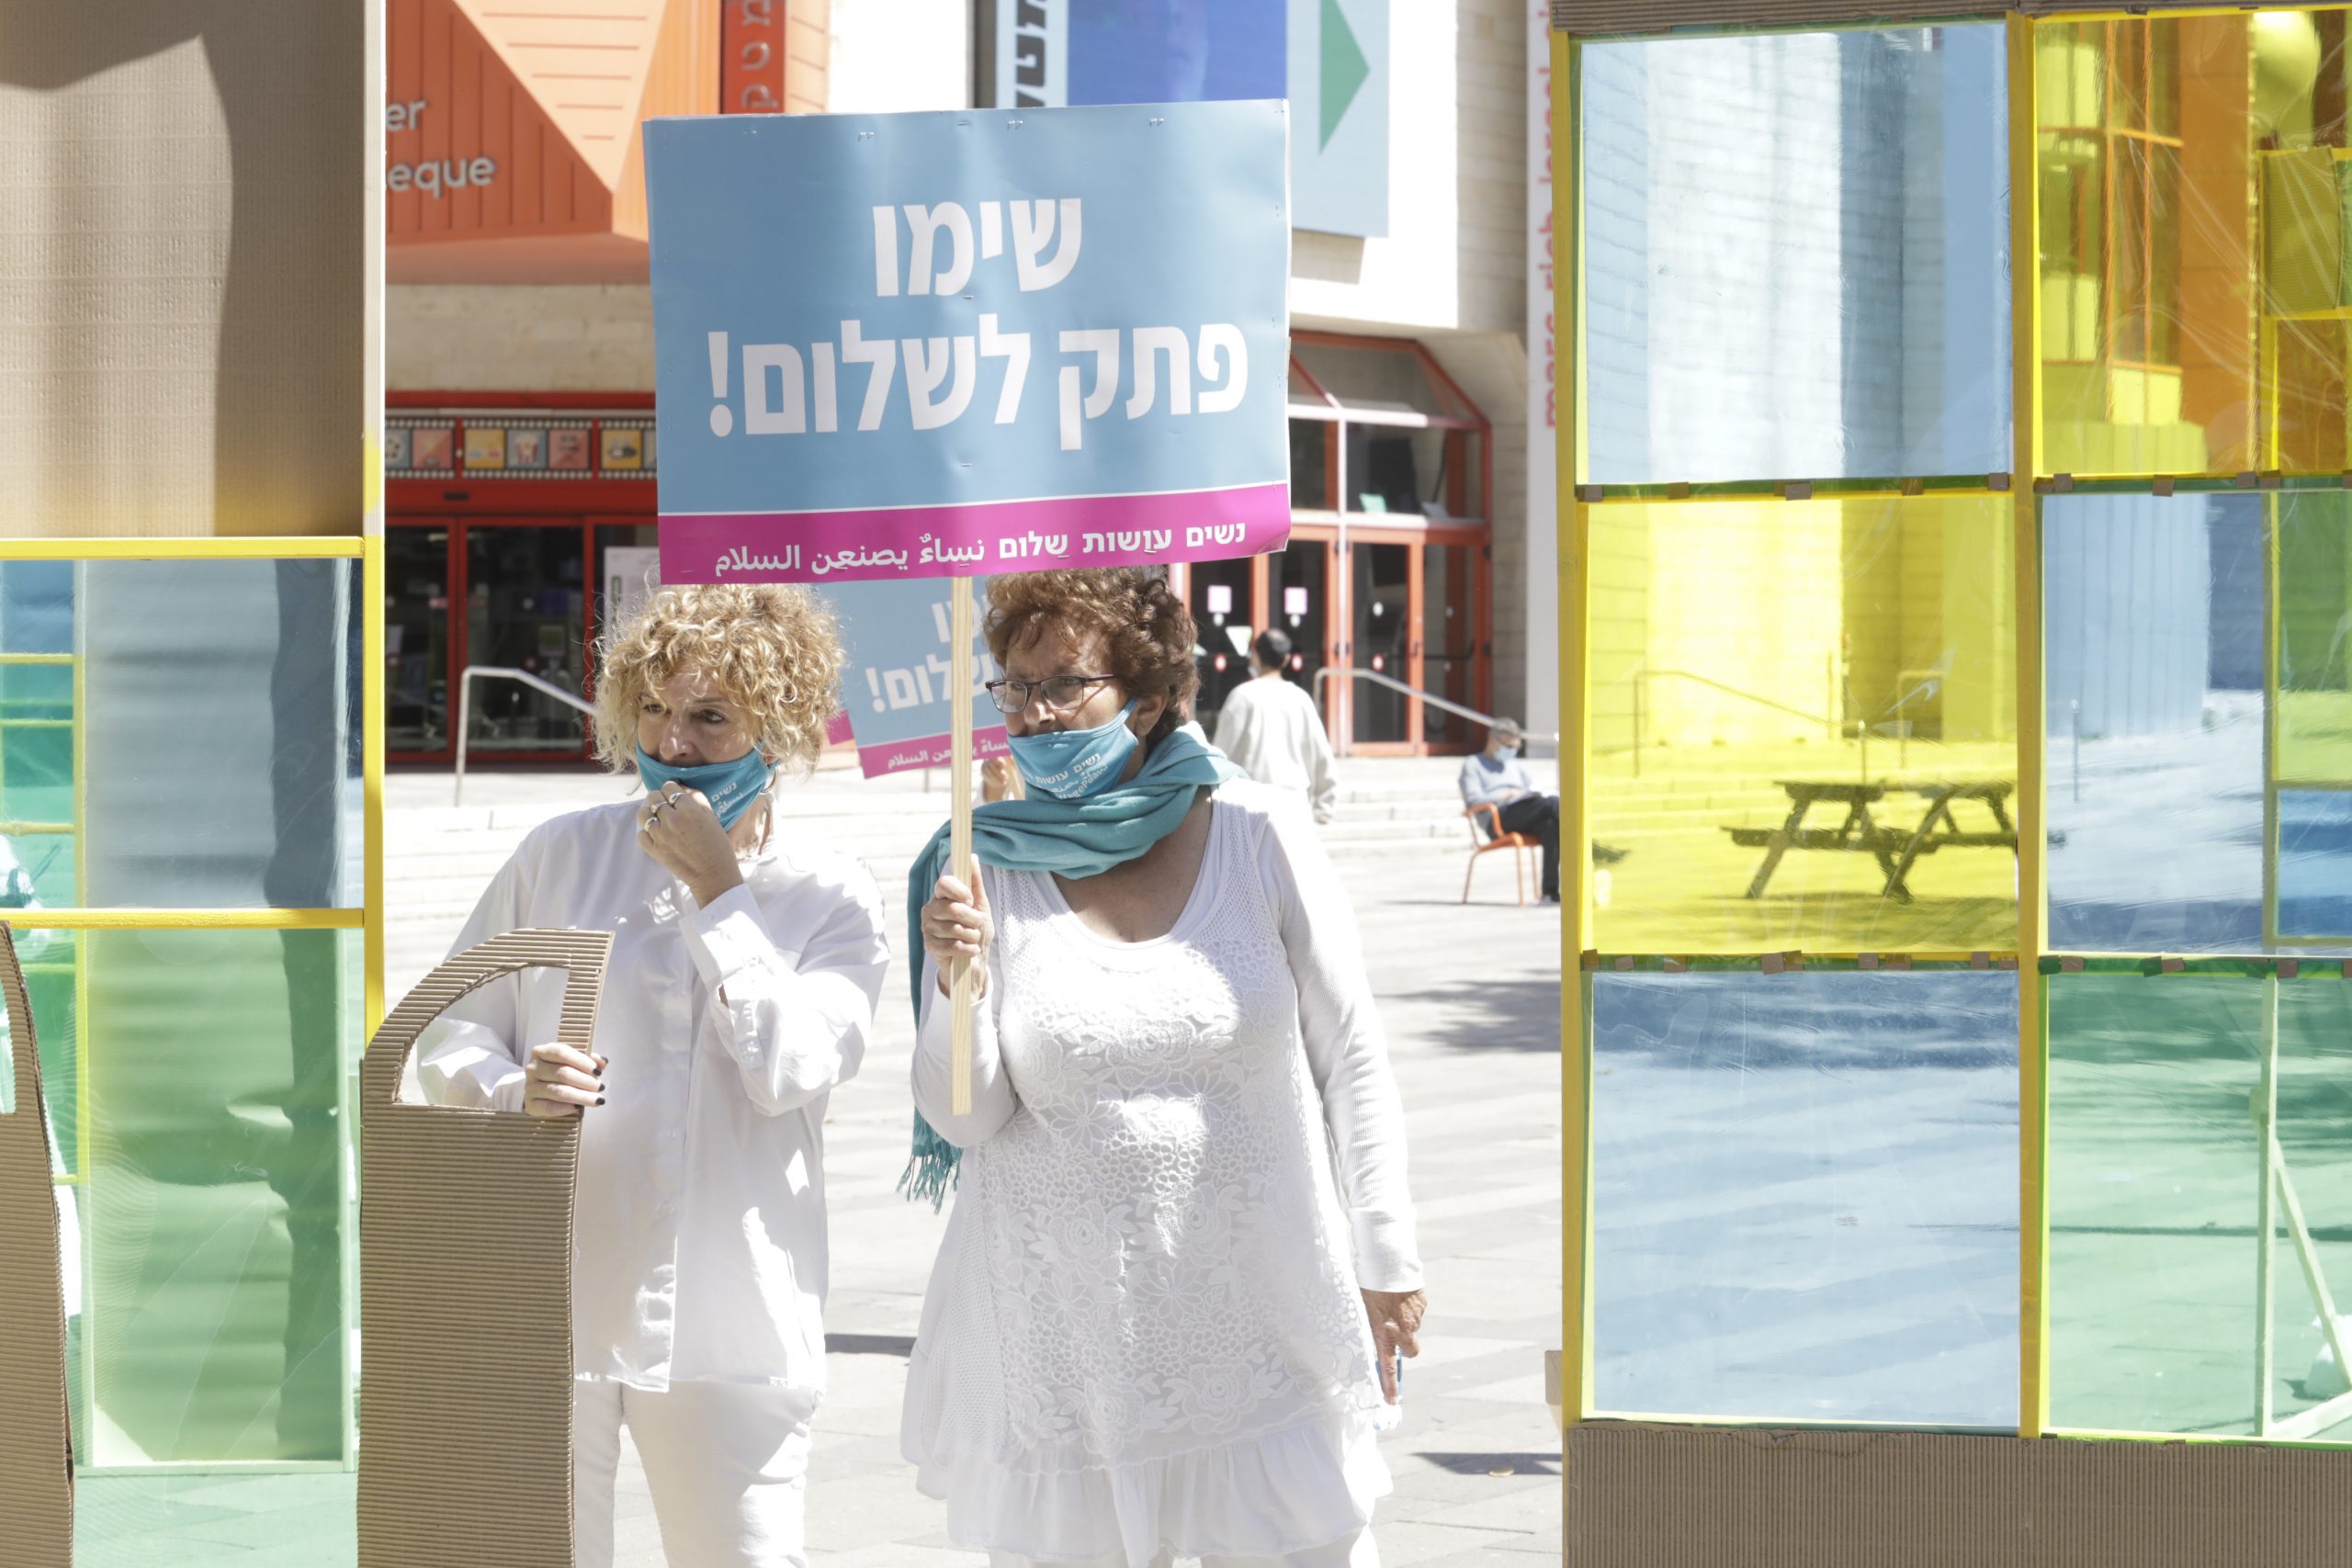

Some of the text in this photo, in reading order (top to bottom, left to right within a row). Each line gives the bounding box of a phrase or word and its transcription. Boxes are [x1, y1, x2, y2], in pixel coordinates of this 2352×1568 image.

[873, 197, 1082, 298] שימו
[707, 312, 1249, 451] פתק לשלום!
[999, 522, 1247, 558] נשים עושות שלום
[716, 545, 800, 577] السلام
[811, 545, 909, 575] يصنعن
[865, 653, 995, 713] שלום!
[1073, 752, 1102, 773] נשים
